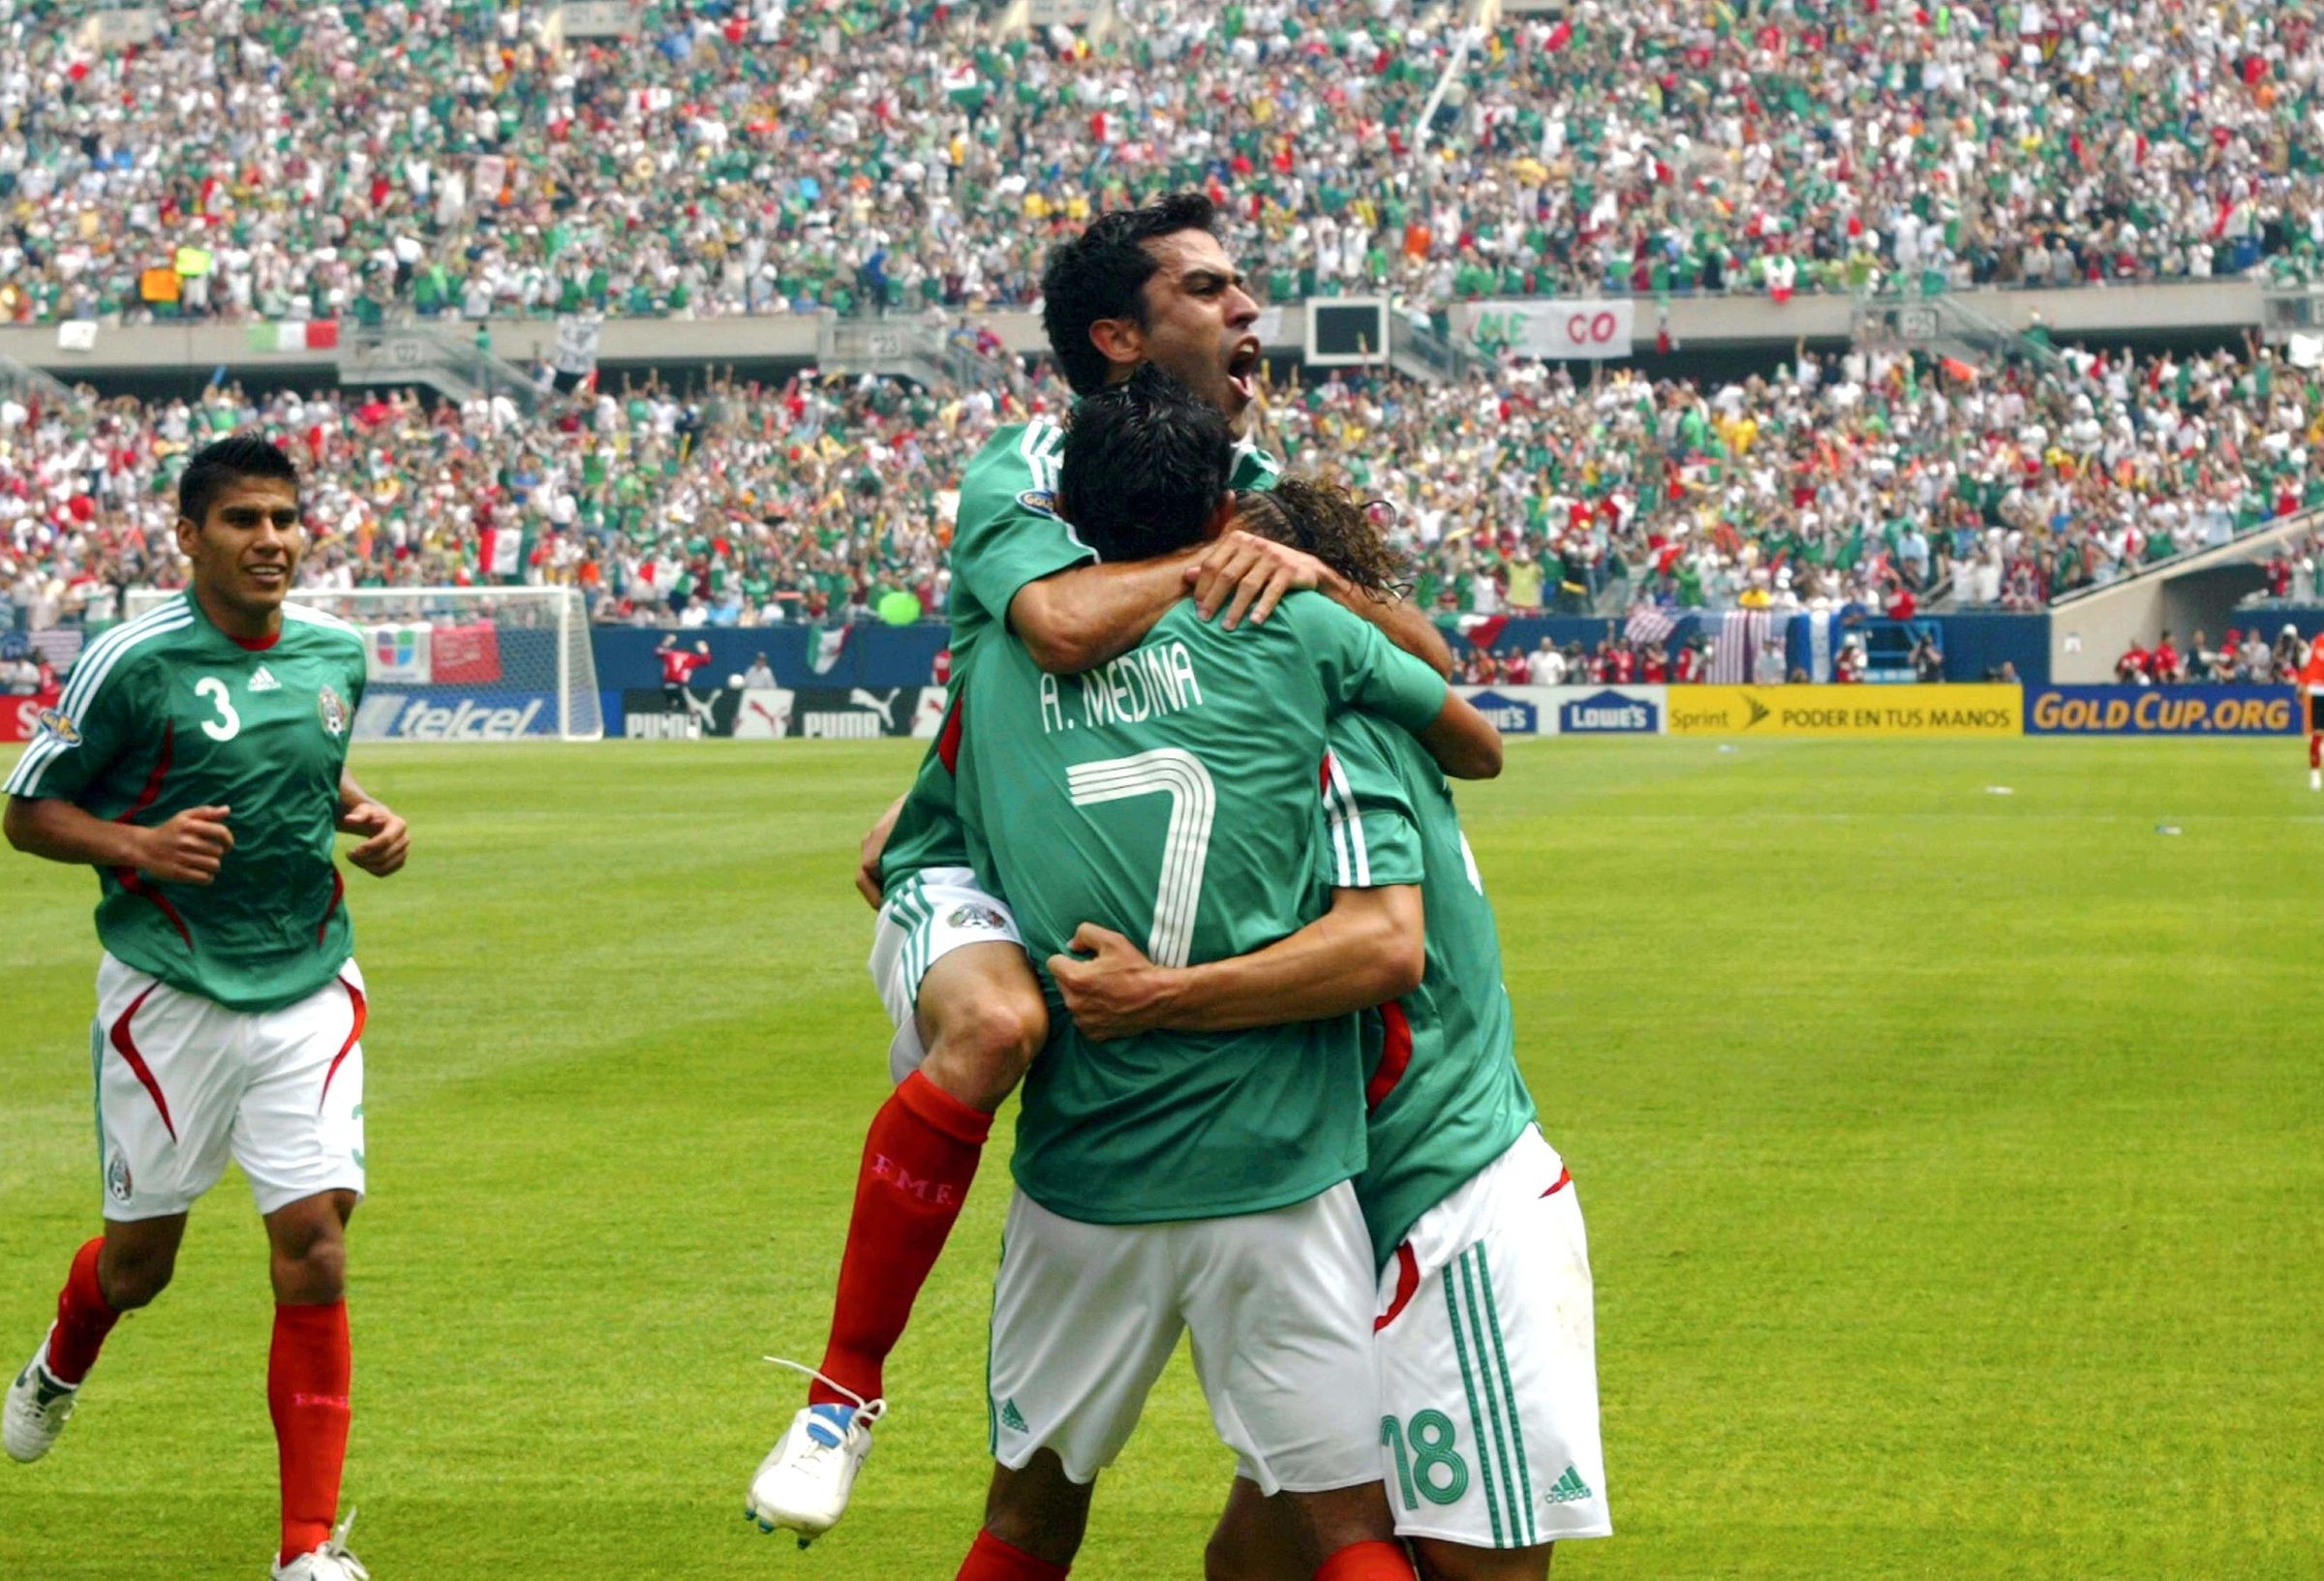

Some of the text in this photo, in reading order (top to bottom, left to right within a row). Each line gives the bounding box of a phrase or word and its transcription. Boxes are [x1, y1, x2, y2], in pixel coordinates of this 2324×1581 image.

[195, 676, 240, 742] 3
[1039, 641, 1203, 733] A. MEDINA
[400, 698, 543, 740] telcel
[804, 712, 880, 739] PUMA
[1572, 705, 1647, 729] LOWE'S
[1670, 708, 2010, 731] Sprint PODER EN TUS MANOS
[1066, 747, 1216, 968] 7
[1381, 1409, 1469, 1510] 18
